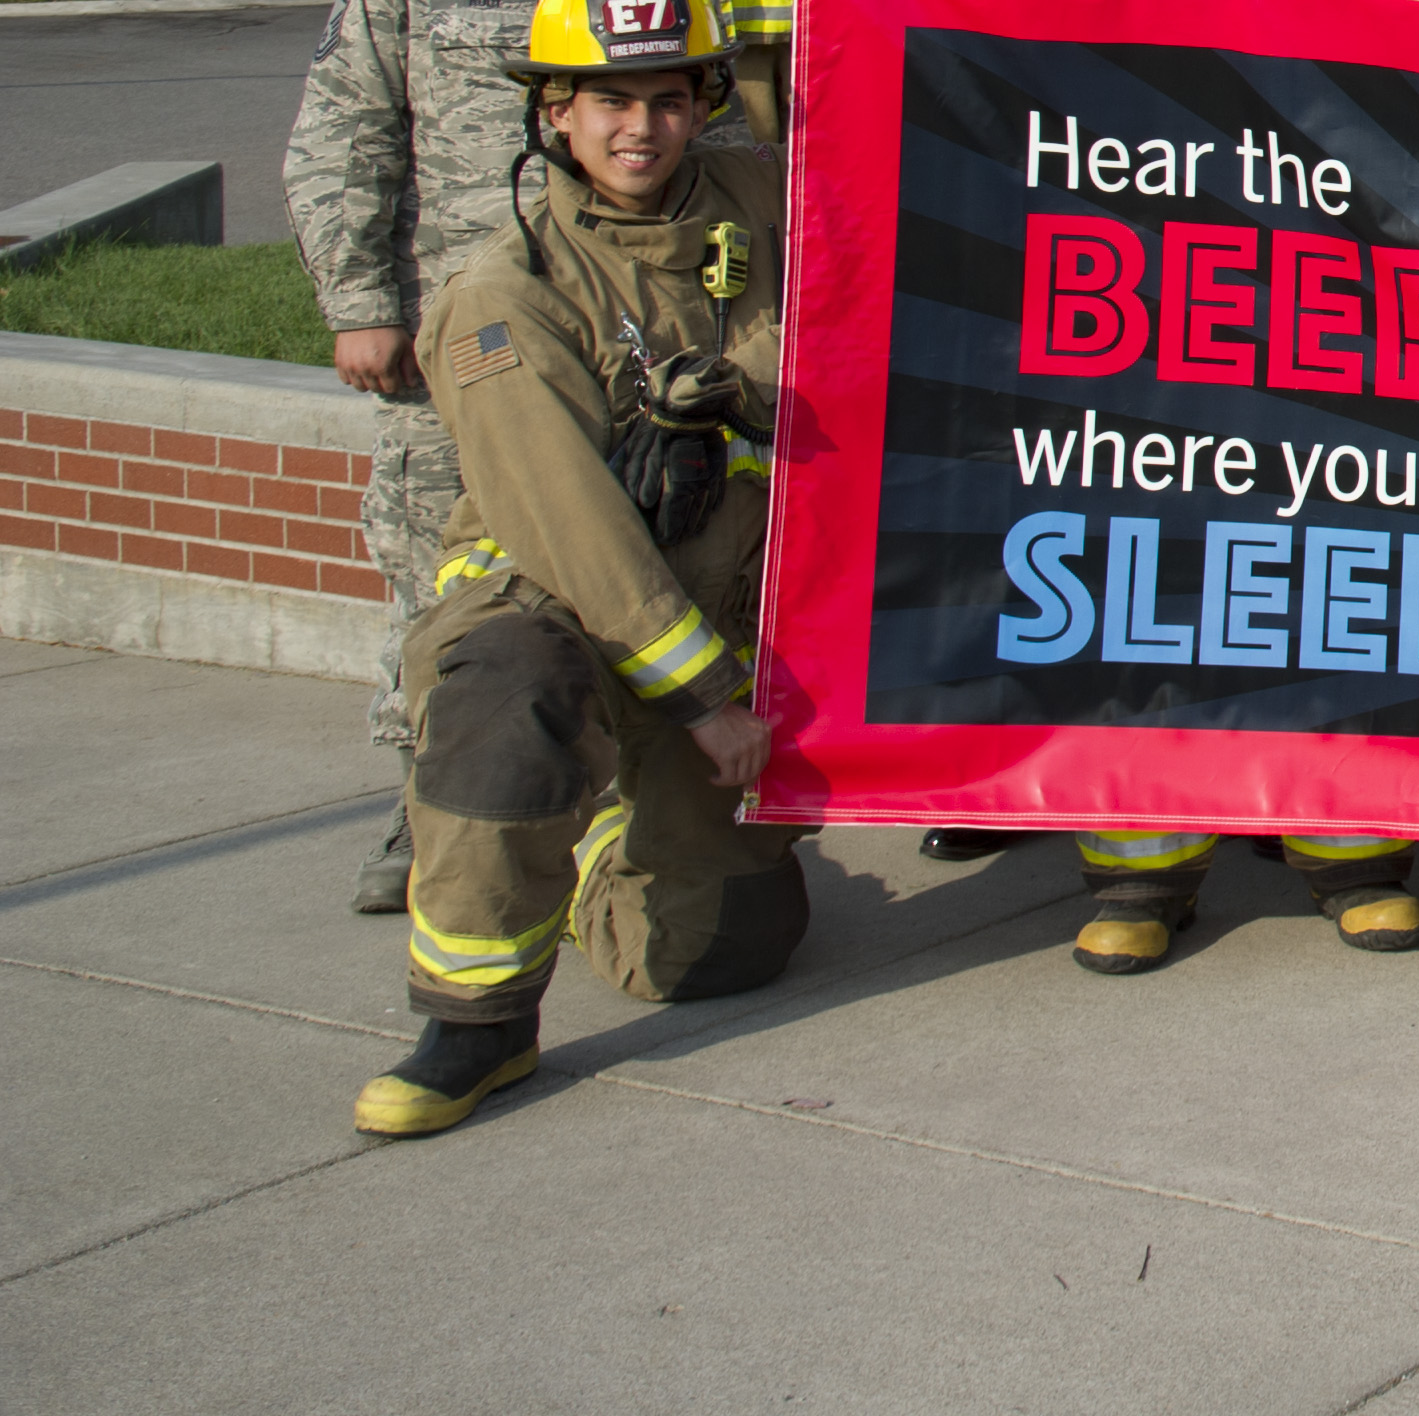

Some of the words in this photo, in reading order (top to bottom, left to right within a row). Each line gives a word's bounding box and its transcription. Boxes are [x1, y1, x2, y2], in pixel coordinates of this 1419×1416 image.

[610, 44, 629, 57] FIRE
[629, 40, 679, 54] DEPARTMENT
[1027, 110, 1214, 198] Hear
[1239, 128, 1351, 216] the
[1013, 409, 1255, 495] where
[1281, 443, 1417, 518] you
